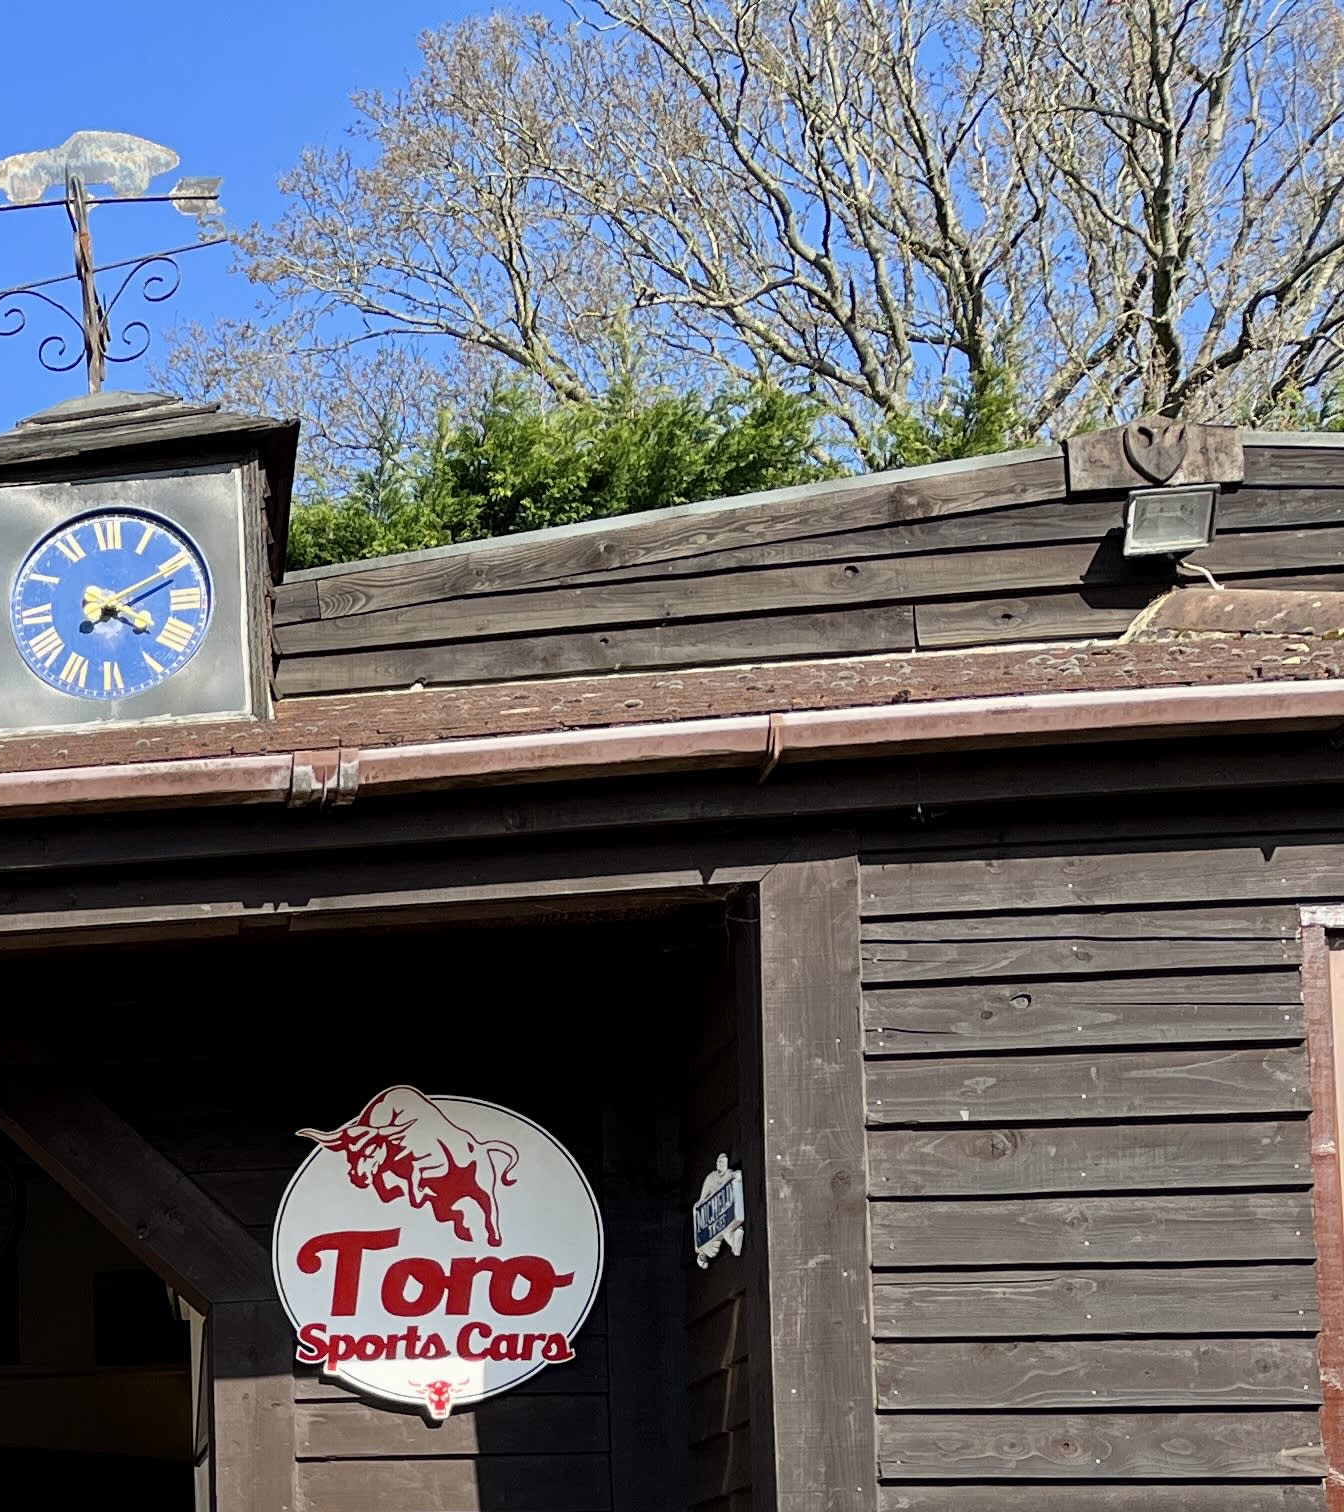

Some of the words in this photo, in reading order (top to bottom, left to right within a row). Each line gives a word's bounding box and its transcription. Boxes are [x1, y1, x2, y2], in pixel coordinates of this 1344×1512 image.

[296, 1227, 575, 1317] Toro
[297, 1322, 450, 1371] Sports
[456, 1321, 576, 1363] Cars
